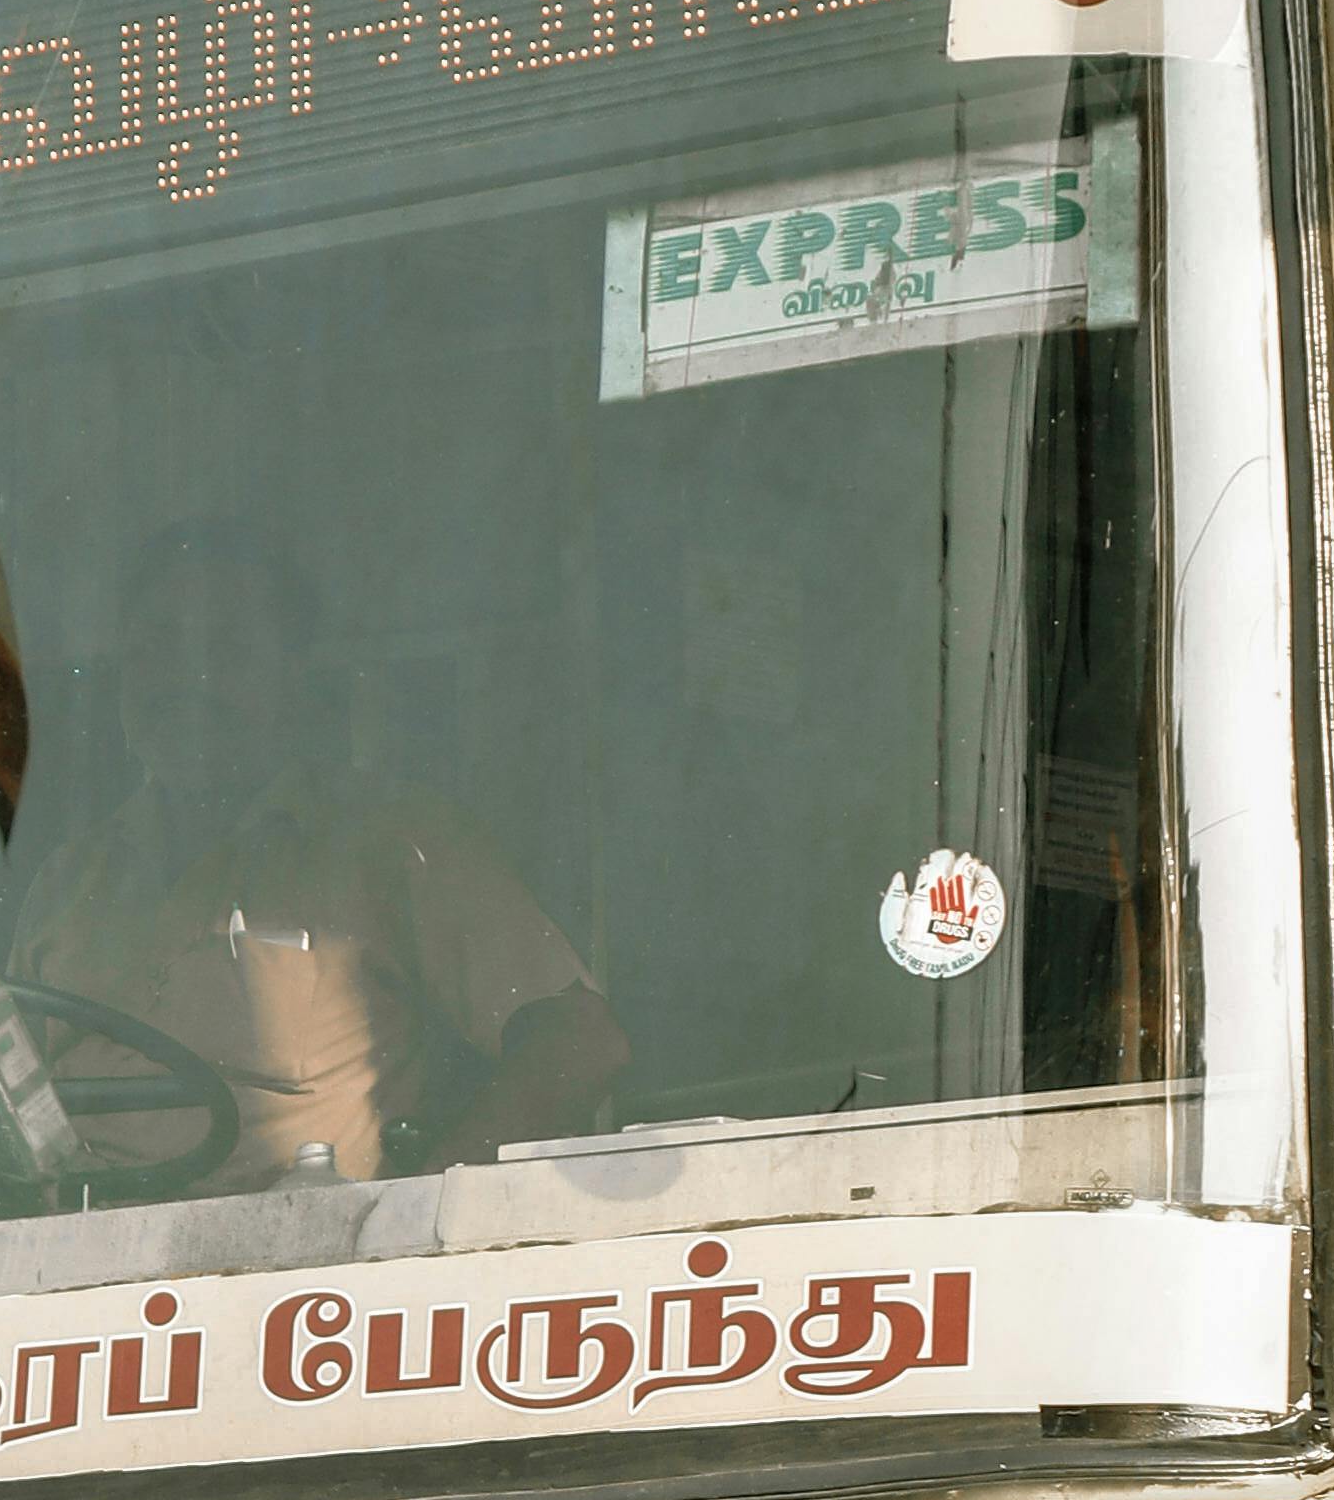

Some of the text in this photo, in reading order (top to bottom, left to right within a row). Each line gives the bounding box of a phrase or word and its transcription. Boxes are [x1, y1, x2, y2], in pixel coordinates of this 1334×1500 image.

[650, 172, 1086, 304] EXPRESS
[932, 921, 969, 937] DRUGS
[264, 1239, 972, 1410] பேருந்து
